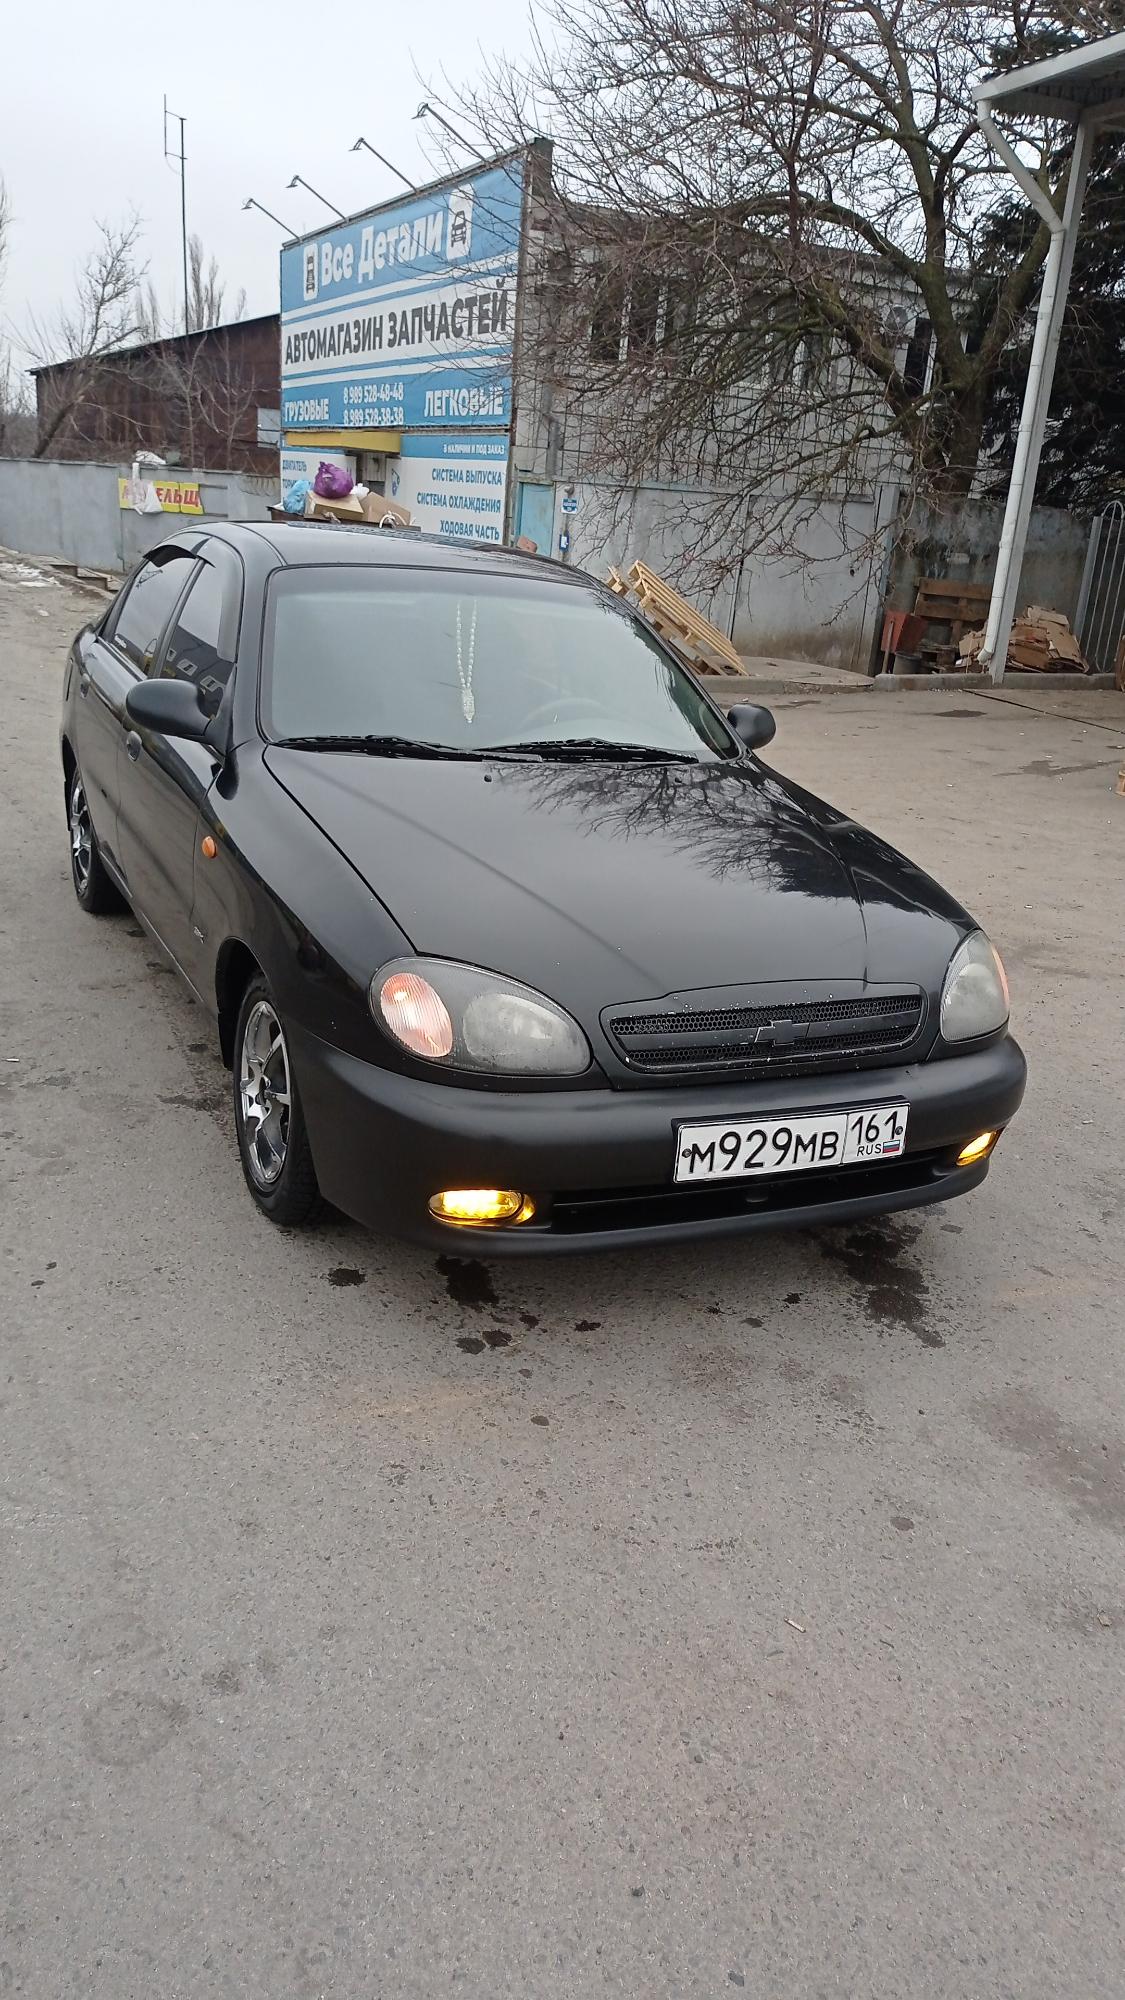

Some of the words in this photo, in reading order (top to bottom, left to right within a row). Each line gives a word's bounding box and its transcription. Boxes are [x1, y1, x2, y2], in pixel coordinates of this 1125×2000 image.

[321, 242, 354, 286] Все
[358, 210, 444, 284] Детали
[285, 315, 383, 365] АВТОМАГАЗИН
[387, 279, 509, 348] ЗАПЧАСТЕЙ
[284, 398, 330, 422] ГРУЗОВЫЕ
[423, 386, 504, 418] ЛЕГКОВЫЕ
[343, 386, 349, 404] 8
[431, 468, 464, 483] СИСТЕМА
[465, 470, 503, 486] ВЫПУСКА
[416, 492, 448, 508] СИСТЕМА
[448, 495, 501, 513] ОХЛАЖДЕНИЯ
[440, 519, 473, 537] ХОДОВАЯ
[474, 524, 500, 540] ЧАСТЬ
[689, 1127, 839, 1174] М929МВ
[850, 1110, 899, 1146] 161
[856, 1143, 882, 1157] RUS
